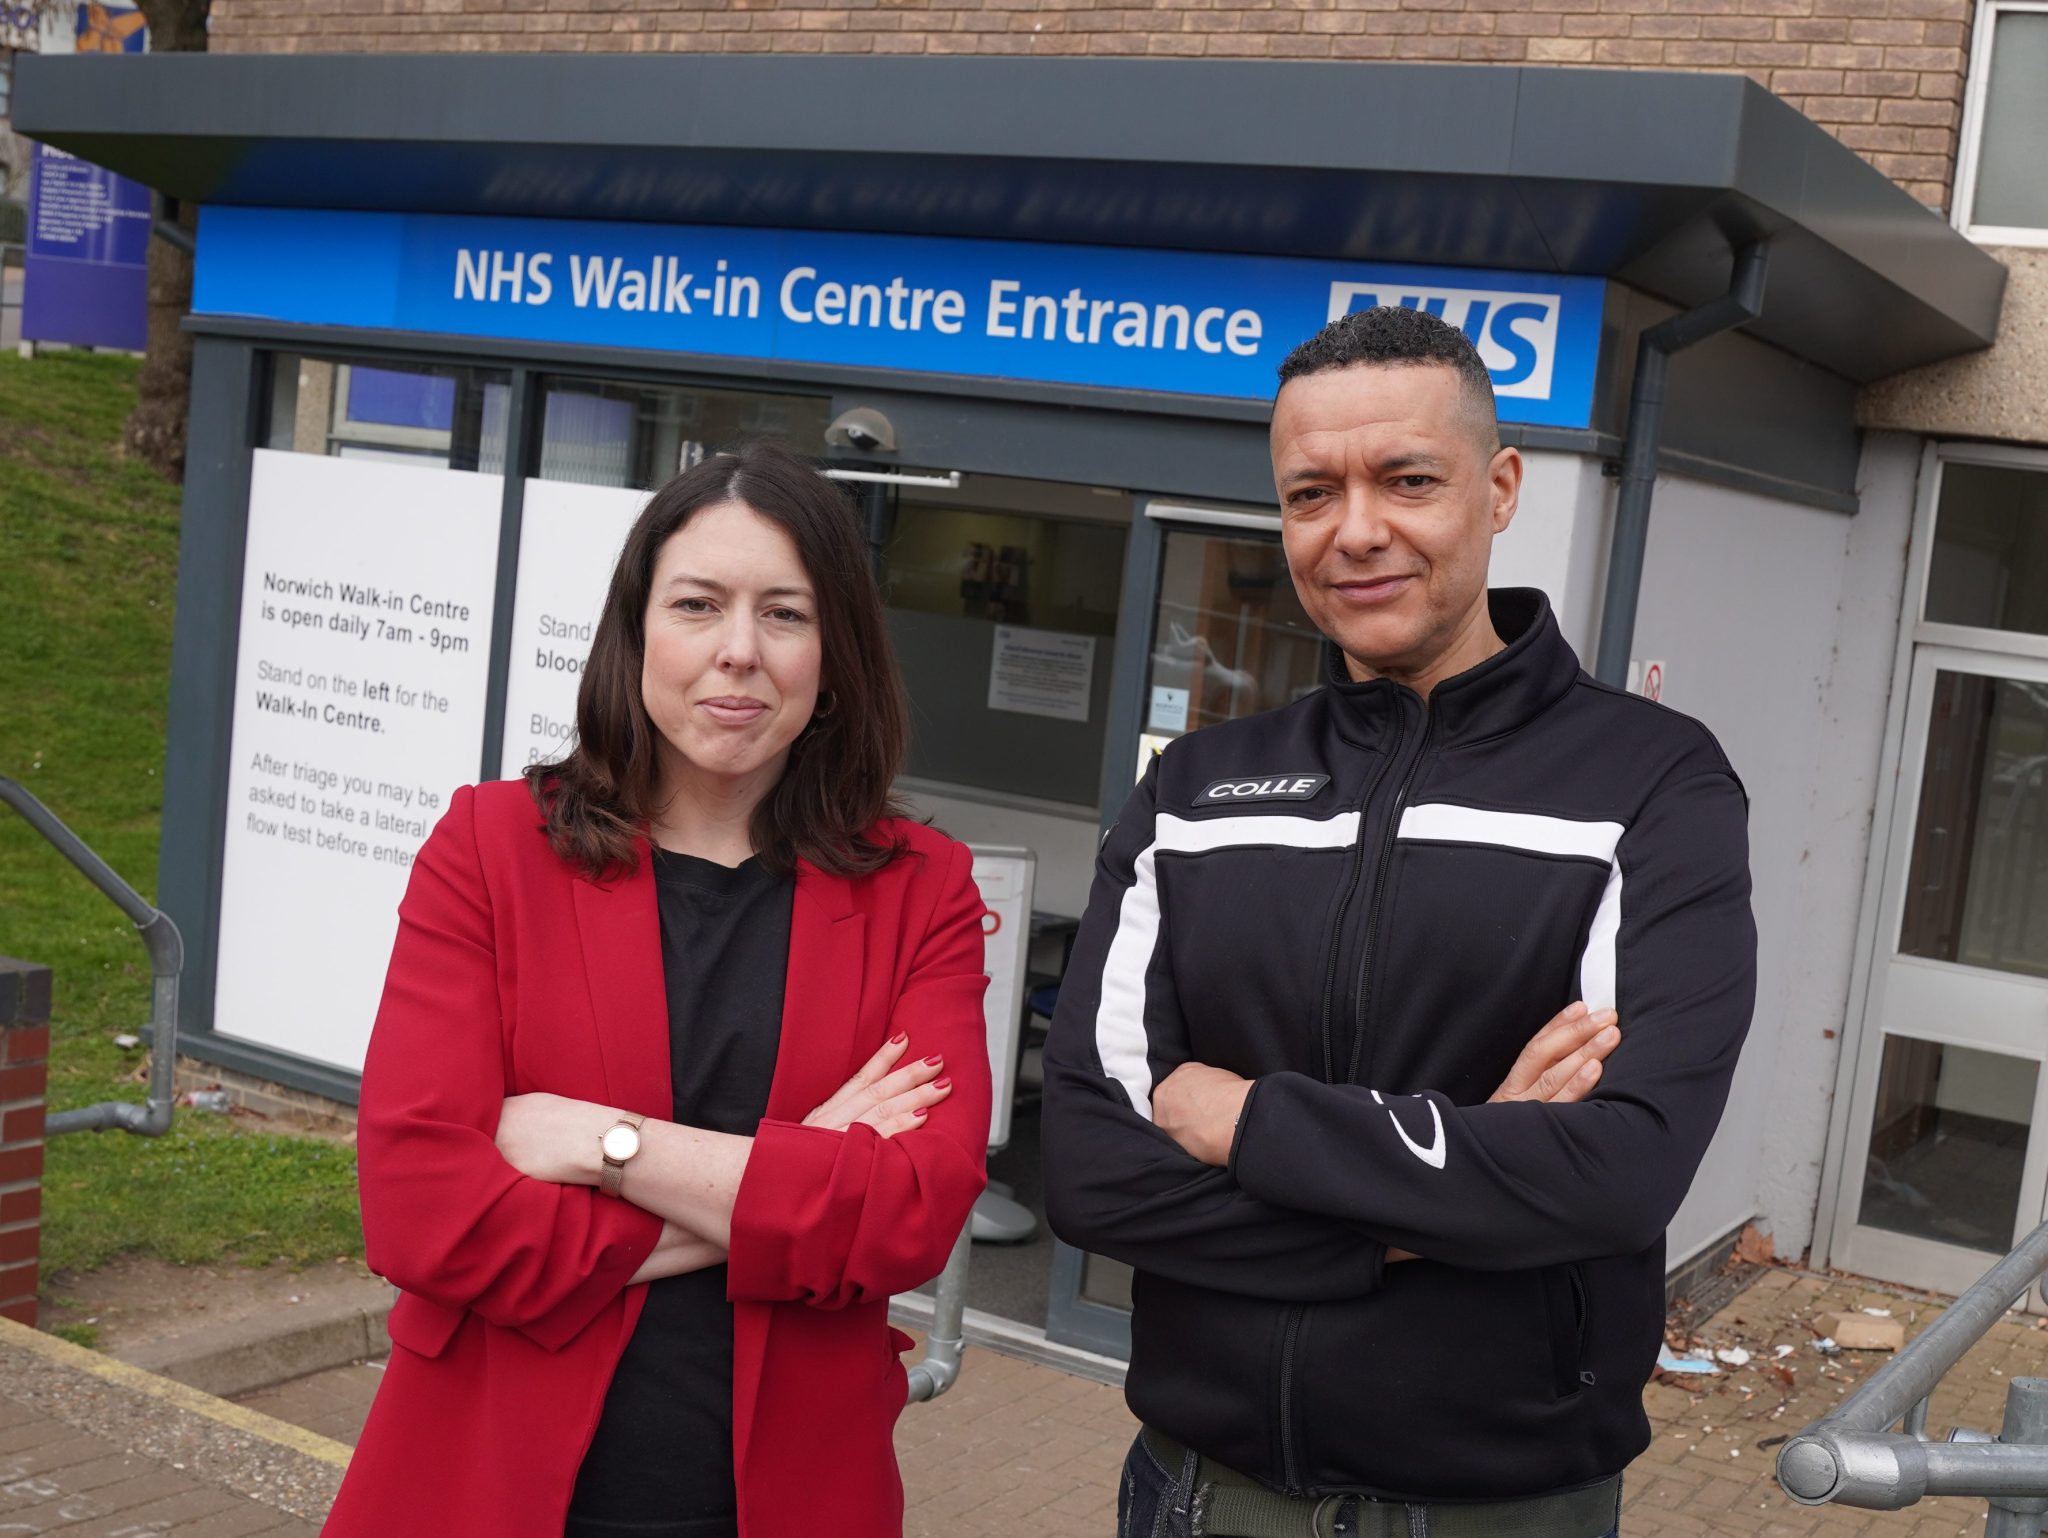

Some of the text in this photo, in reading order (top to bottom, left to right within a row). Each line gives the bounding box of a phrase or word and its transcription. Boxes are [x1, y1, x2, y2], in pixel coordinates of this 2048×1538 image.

[453, 249, 1264, 356] NHS Walk-in Centre Entrance
[264, 571, 470, 621] Norwich Walk-in Centre
[261, 600, 275, 620] is
[281, 606, 323, 629] open
[329, 612, 370, 641] daily
[376, 619, 412, 643] 7am
[430, 628, 469, 654] 9pm
[538, 614, 591, 642] Stand
[257, 659, 449, 713] Stand on the left for the
[256, 691, 386, 734] Walk-In Centre.
[250, 752, 440, 809] After triage you may be
[1208, 778, 1317, 798] COLLE
[246, 812, 279, 837] flow
[283, 821, 312, 845] test
[316, 828, 368, 857] before
[249, 785, 427, 838] asked to take a lateral
